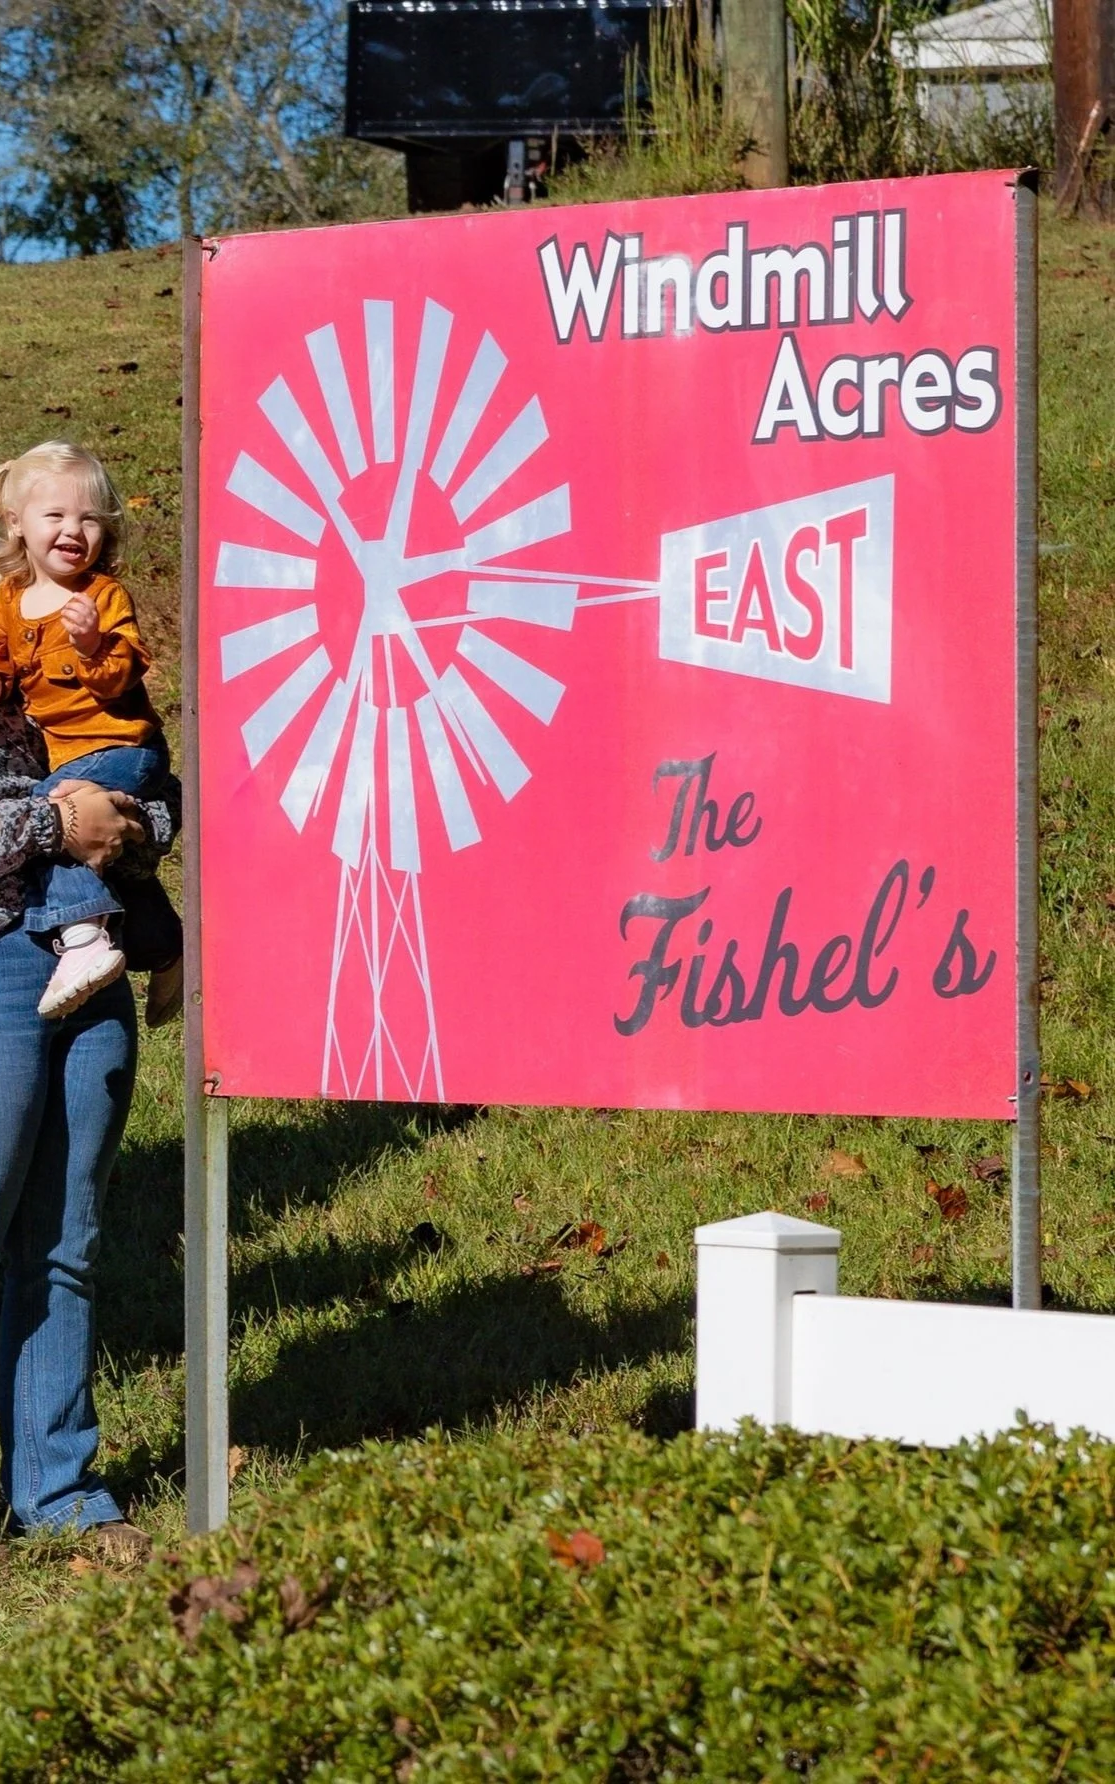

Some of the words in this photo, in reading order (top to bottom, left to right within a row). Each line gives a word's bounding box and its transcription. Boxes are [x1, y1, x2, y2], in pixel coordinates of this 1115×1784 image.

[537, 207, 914, 345] Windmill
[751, 332, 1000, 445] Acres
[693, 505, 868, 672] EAST
[650, 750, 763, 863] The
[613, 858, 997, 1037] Fishel's
